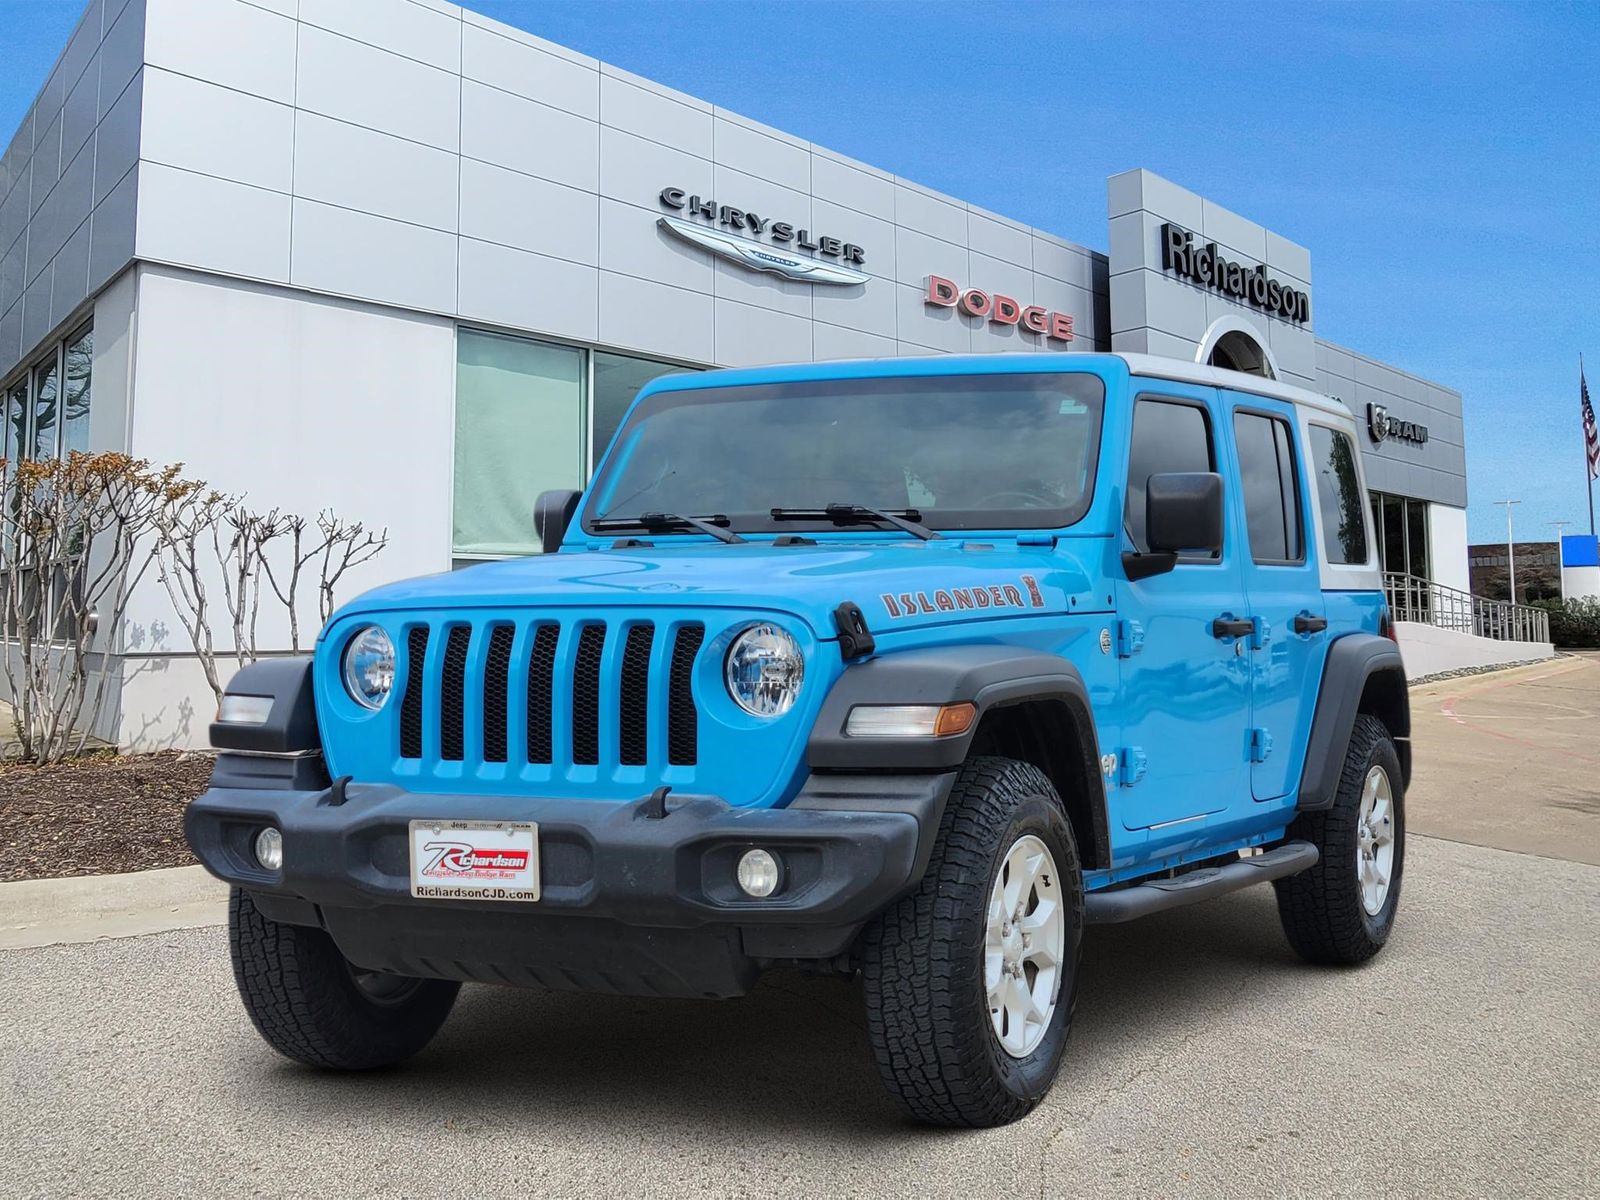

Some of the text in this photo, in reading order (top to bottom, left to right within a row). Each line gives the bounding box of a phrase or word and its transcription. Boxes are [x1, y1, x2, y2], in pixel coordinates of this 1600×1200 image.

[659, 186, 866, 264] CHRYSLER
[1160, 222, 1311, 323] Richardson
[924, 274, 1075, 342] DODGE
[1387, 416, 1429, 443] RAM
[881, 584, 1025, 619] ISLANDER
[421, 841, 526, 876] Richardson
[416, 886, 535, 900] RichardsonCJD.com
